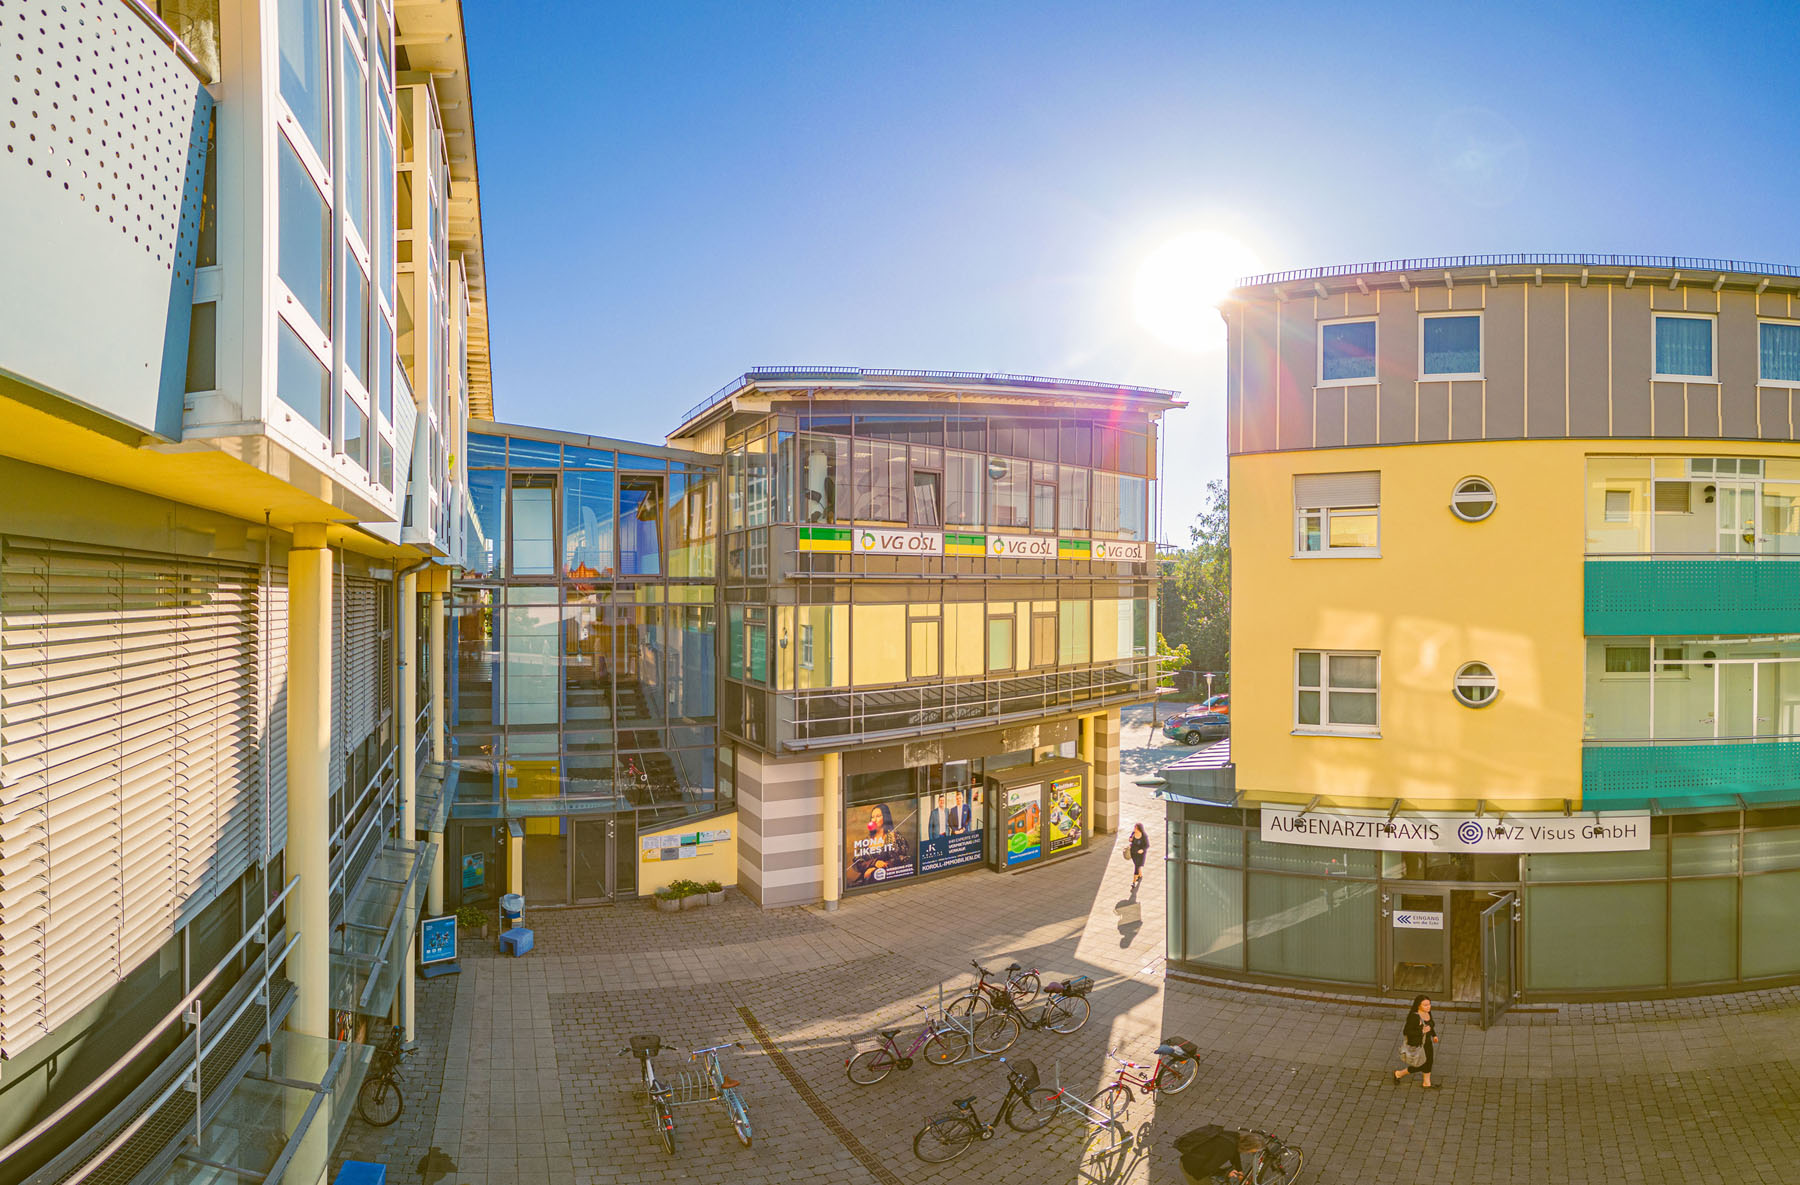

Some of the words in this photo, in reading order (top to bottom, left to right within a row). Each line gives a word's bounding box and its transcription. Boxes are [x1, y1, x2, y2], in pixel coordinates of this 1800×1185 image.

[881, 535, 904, 550] VG
[908, 536, 936, 551] OSL
[1008, 541, 1027, 554] VG
[1030, 542, 1053, 555] OSL
[1108, 546, 1122, 558] VG
[1125, 547, 1143, 558] OSL
[1270, 815, 1440, 841] AUGENARZTPRAXIS
[1487, 826, 1524, 840] MVZ
[1530, 826, 1575, 840] Visus
[1582, 824, 1637, 839] GmbH
[854, 837, 885, 848] MONA
[854, 846, 882, 857] LIKES
[884, 843, 895, 852] IT.
